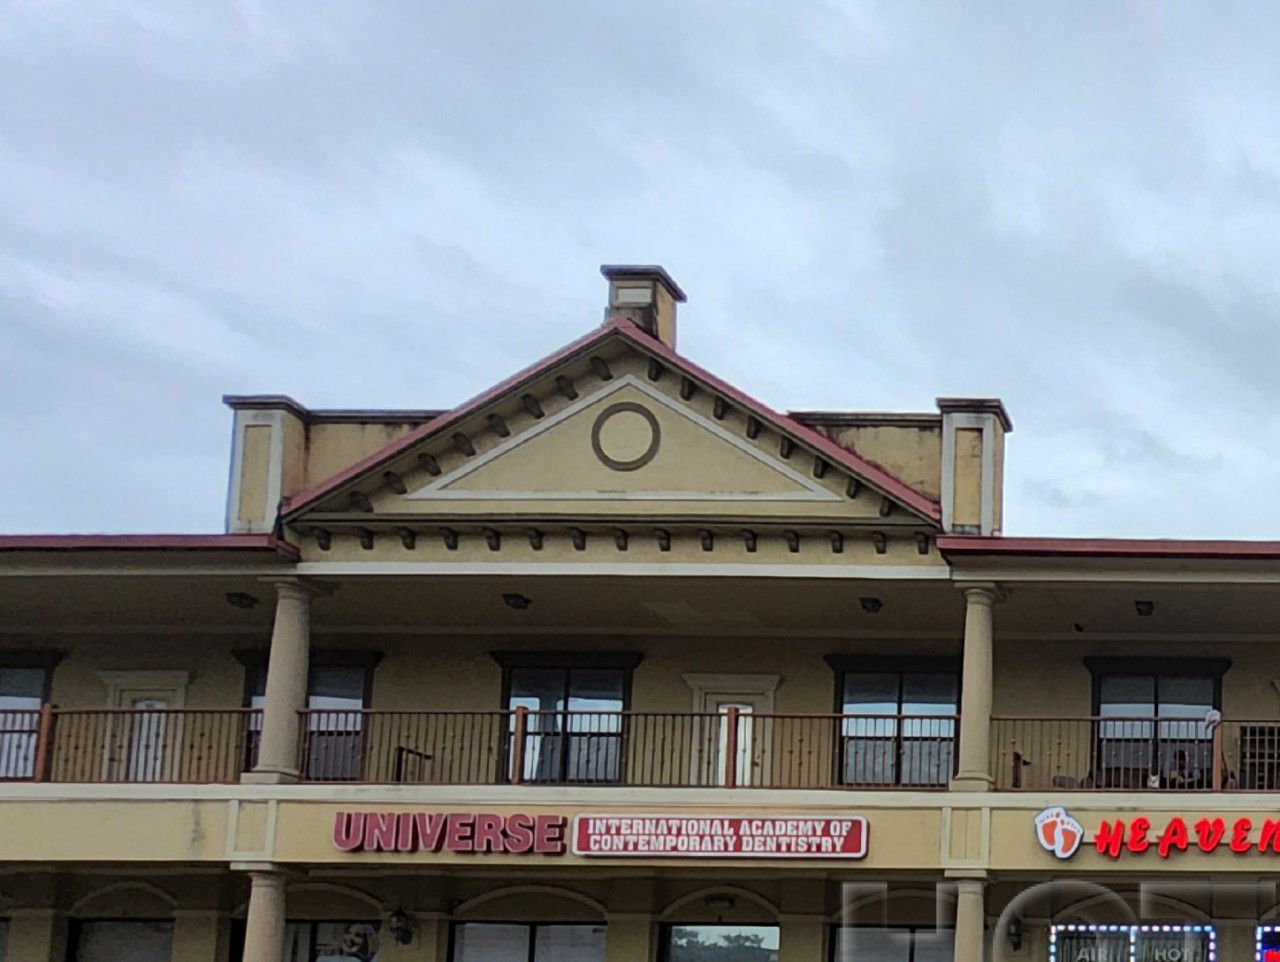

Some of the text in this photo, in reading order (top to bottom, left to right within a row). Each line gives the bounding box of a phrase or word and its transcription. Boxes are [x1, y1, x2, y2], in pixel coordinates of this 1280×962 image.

[333, 811, 567, 855] UNIVERSE
[587, 819, 852, 837] INTERNATIONAL ACADEMY OF
[589, 834, 845, 853] CONTEMPORARY DENTISTRY
[1077, 948, 1109, 962] AIR
[1155, 948, 1192, 962] HOT
